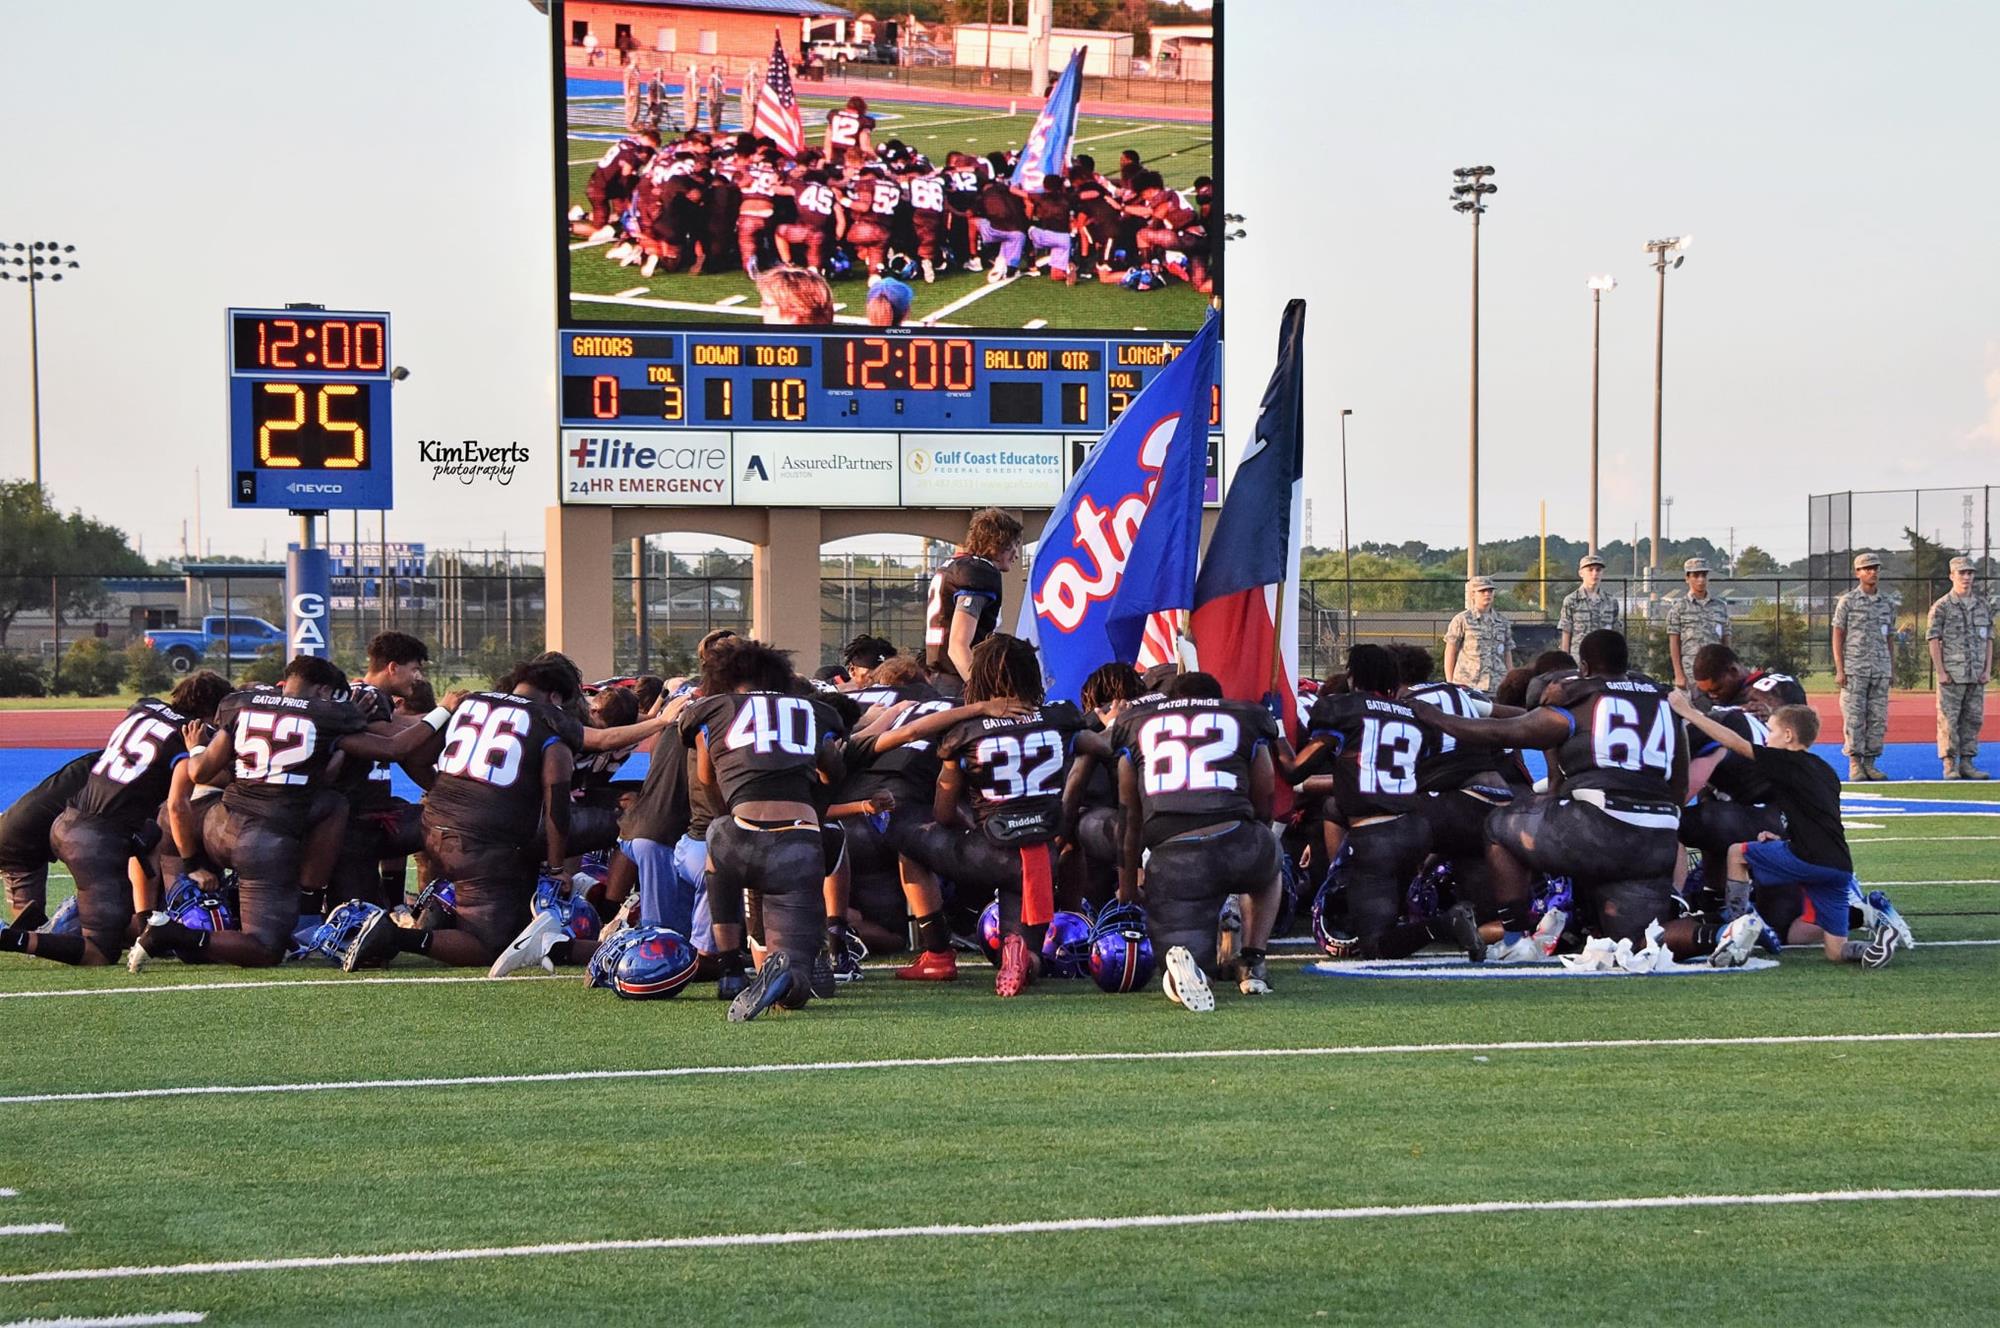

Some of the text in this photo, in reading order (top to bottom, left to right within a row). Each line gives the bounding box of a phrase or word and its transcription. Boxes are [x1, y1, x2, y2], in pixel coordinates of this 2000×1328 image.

[831, 115, 859, 145] 12
[799, 185, 833, 215] 45
[872, 185, 900, 214] 52
[258, 320, 383, 369] 12:00
[573, 337, 633, 357] GATORS
[695, 346, 739, 365] DOWN
[756, 346, 798, 365] TO GO
[648, 367, 675, 382] TOL
[847, 338, 972, 390] 12:00
[985, 351, 1048, 370] BALL ON
[1062, 352, 1089, 370] QTR
[1109, 374, 1133, 388] TOL
[593, 375, 618, 419] 0
[664, 386, 682, 419] 3
[722, 381, 731, 416] 1
[770, 379, 805, 420] 10
[1080, 385, 1087, 421] 1
[259, 383, 364, 468] 25
[570, 438, 725, 469] Elitecare
[781, 455, 893, 470] AssuredPartners
[935, 451, 1059, 465] Gulf Coast Educators
[570, 479, 725, 495] 24HR EMERGENCY
[252, 695, 309, 709] GATOR PRIDE
[1158, 699, 1187, 710] GATOR
[1366, 700, 1414, 718] GATOR PRIDE
[726, 696, 816, 755] 40
[1593, 696, 1675, 781] 64
[92, 712, 176, 784] 45
[234, 709, 317, 786] 52
[438, 700, 530, 786] 66
[1138, 713, 1239, 796] 62
[1359, 718, 1422, 794] 13
[977, 730, 1064, 800] 32
